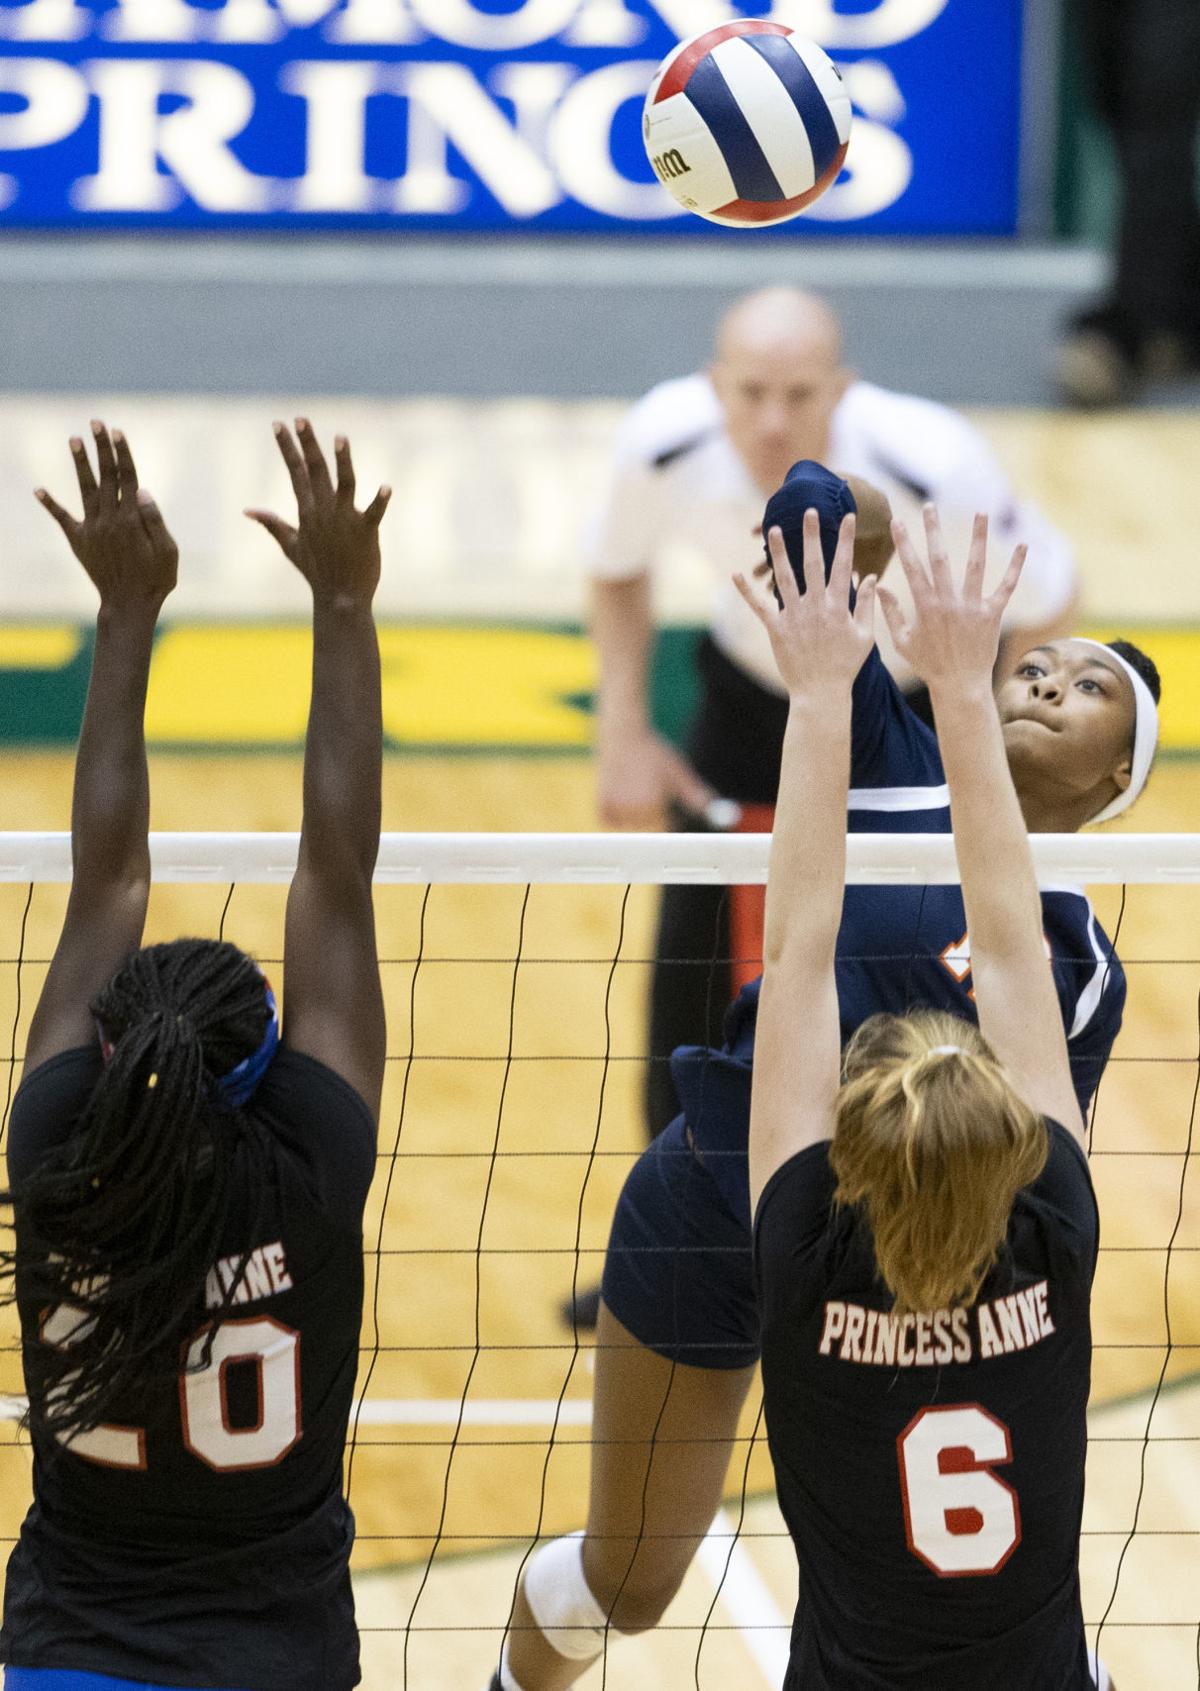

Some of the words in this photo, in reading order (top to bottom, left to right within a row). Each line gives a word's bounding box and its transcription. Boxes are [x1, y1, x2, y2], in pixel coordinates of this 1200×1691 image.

[818, 1301, 973, 1367] PRINCESS
[977, 1280, 1055, 1360] ANNE
[896, 1402, 1022, 1577] 6
